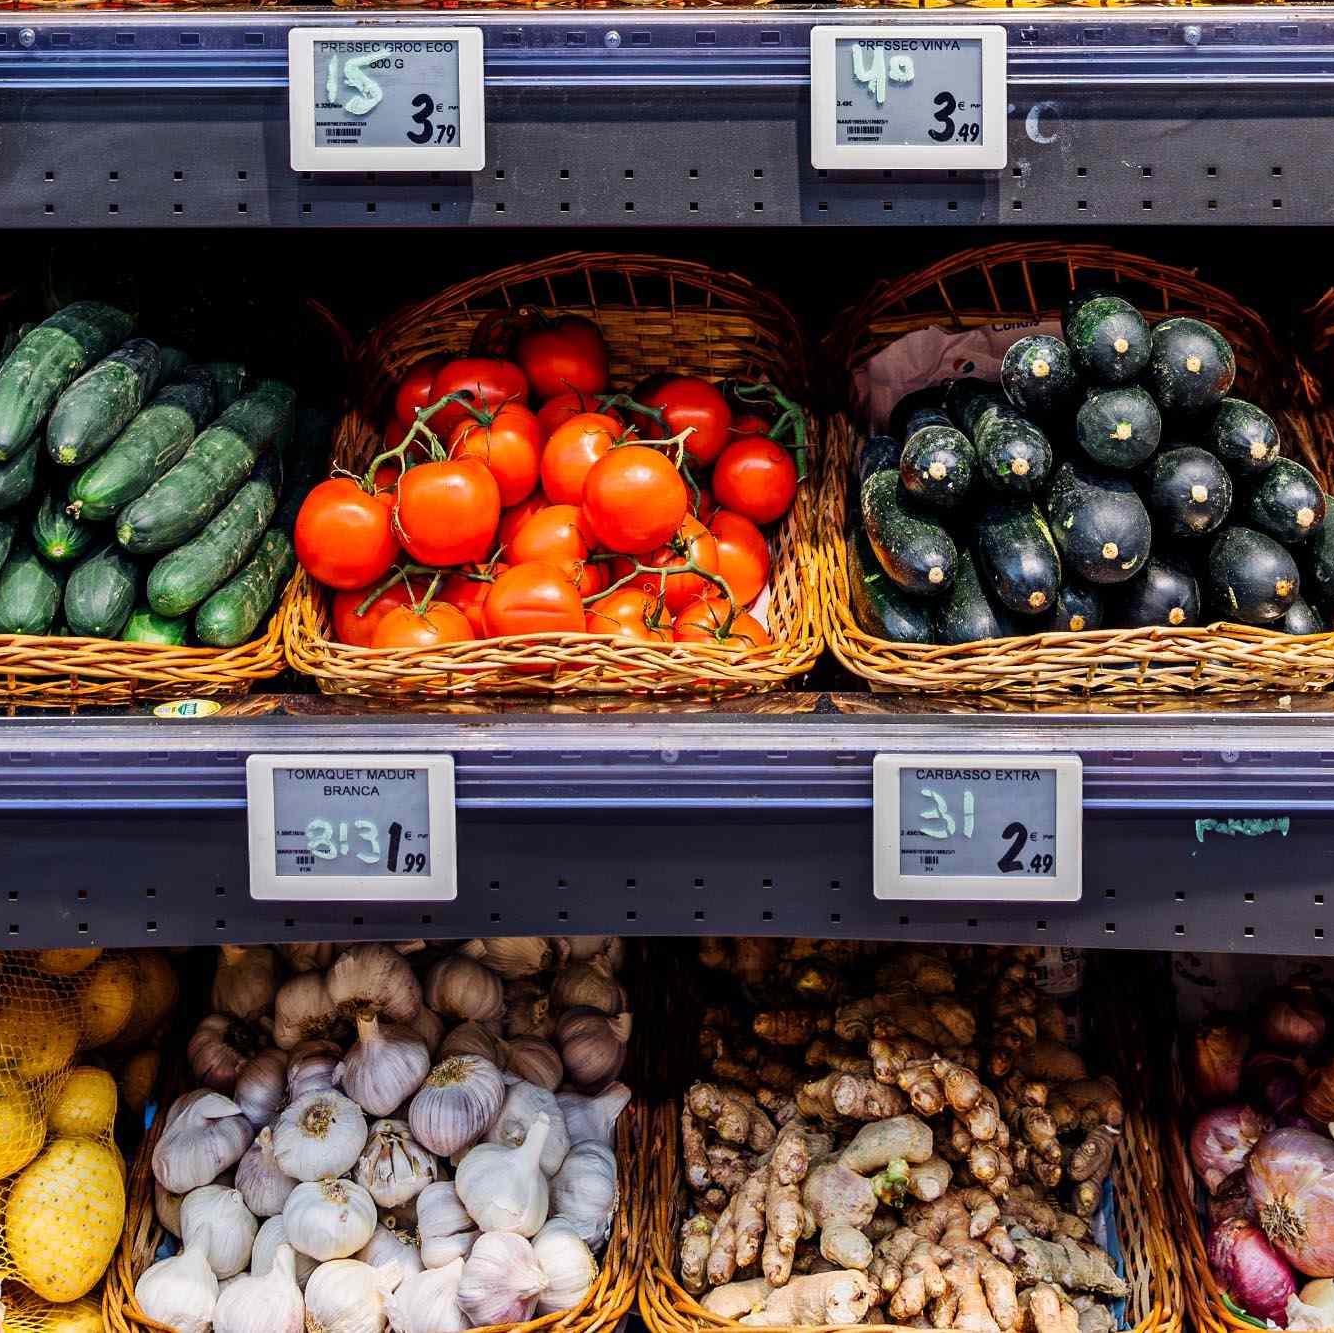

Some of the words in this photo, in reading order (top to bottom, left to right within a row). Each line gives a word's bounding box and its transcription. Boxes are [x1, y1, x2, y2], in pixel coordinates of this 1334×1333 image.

[320, 42, 381, 53] PRESSEC
[384, 42, 422, 53] GROC
[426, 42, 453, 53] ECO
[921, 40, 961, 51] VINYA
[394, 58, 405, 69] G
[286, 769, 364, 780] TOMAQUET
[366, 769, 416, 780] MADUR
[916, 769, 991, 781] CARBASSO
[995, 769, 1041, 781] EXTRA
[323, 785, 380, 796] BRANCA
[920, 788, 975, 839] 31
